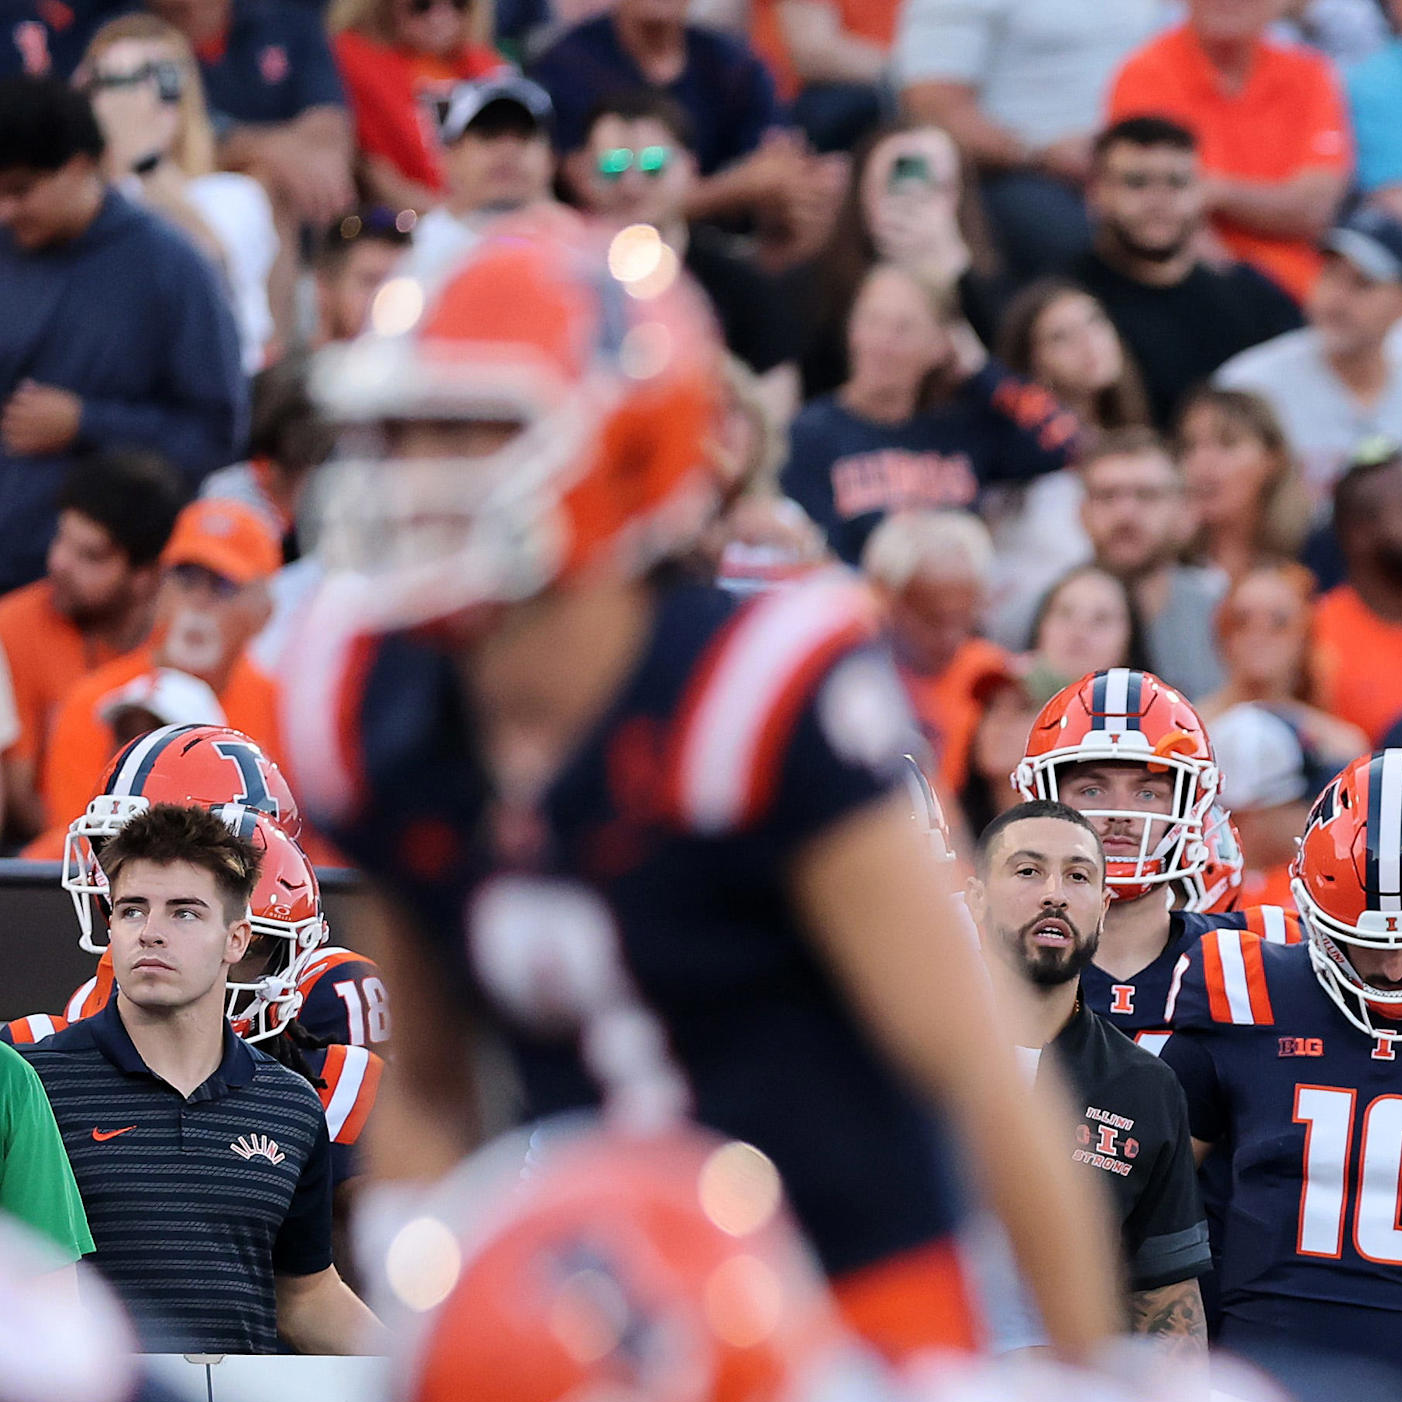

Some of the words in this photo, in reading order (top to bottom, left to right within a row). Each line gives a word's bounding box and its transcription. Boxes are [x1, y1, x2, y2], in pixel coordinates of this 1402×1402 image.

[333, 976, 392, 1046] 18
[1110, 984, 1135, 1015] I
[1371, 1029, 1398, 1061] I
[1085, 1106, 1134, 1131] ILLINI
[230, 1133, 285, 1165] ILLINI
[1072, 1149, 1133, 1176] STRONG
